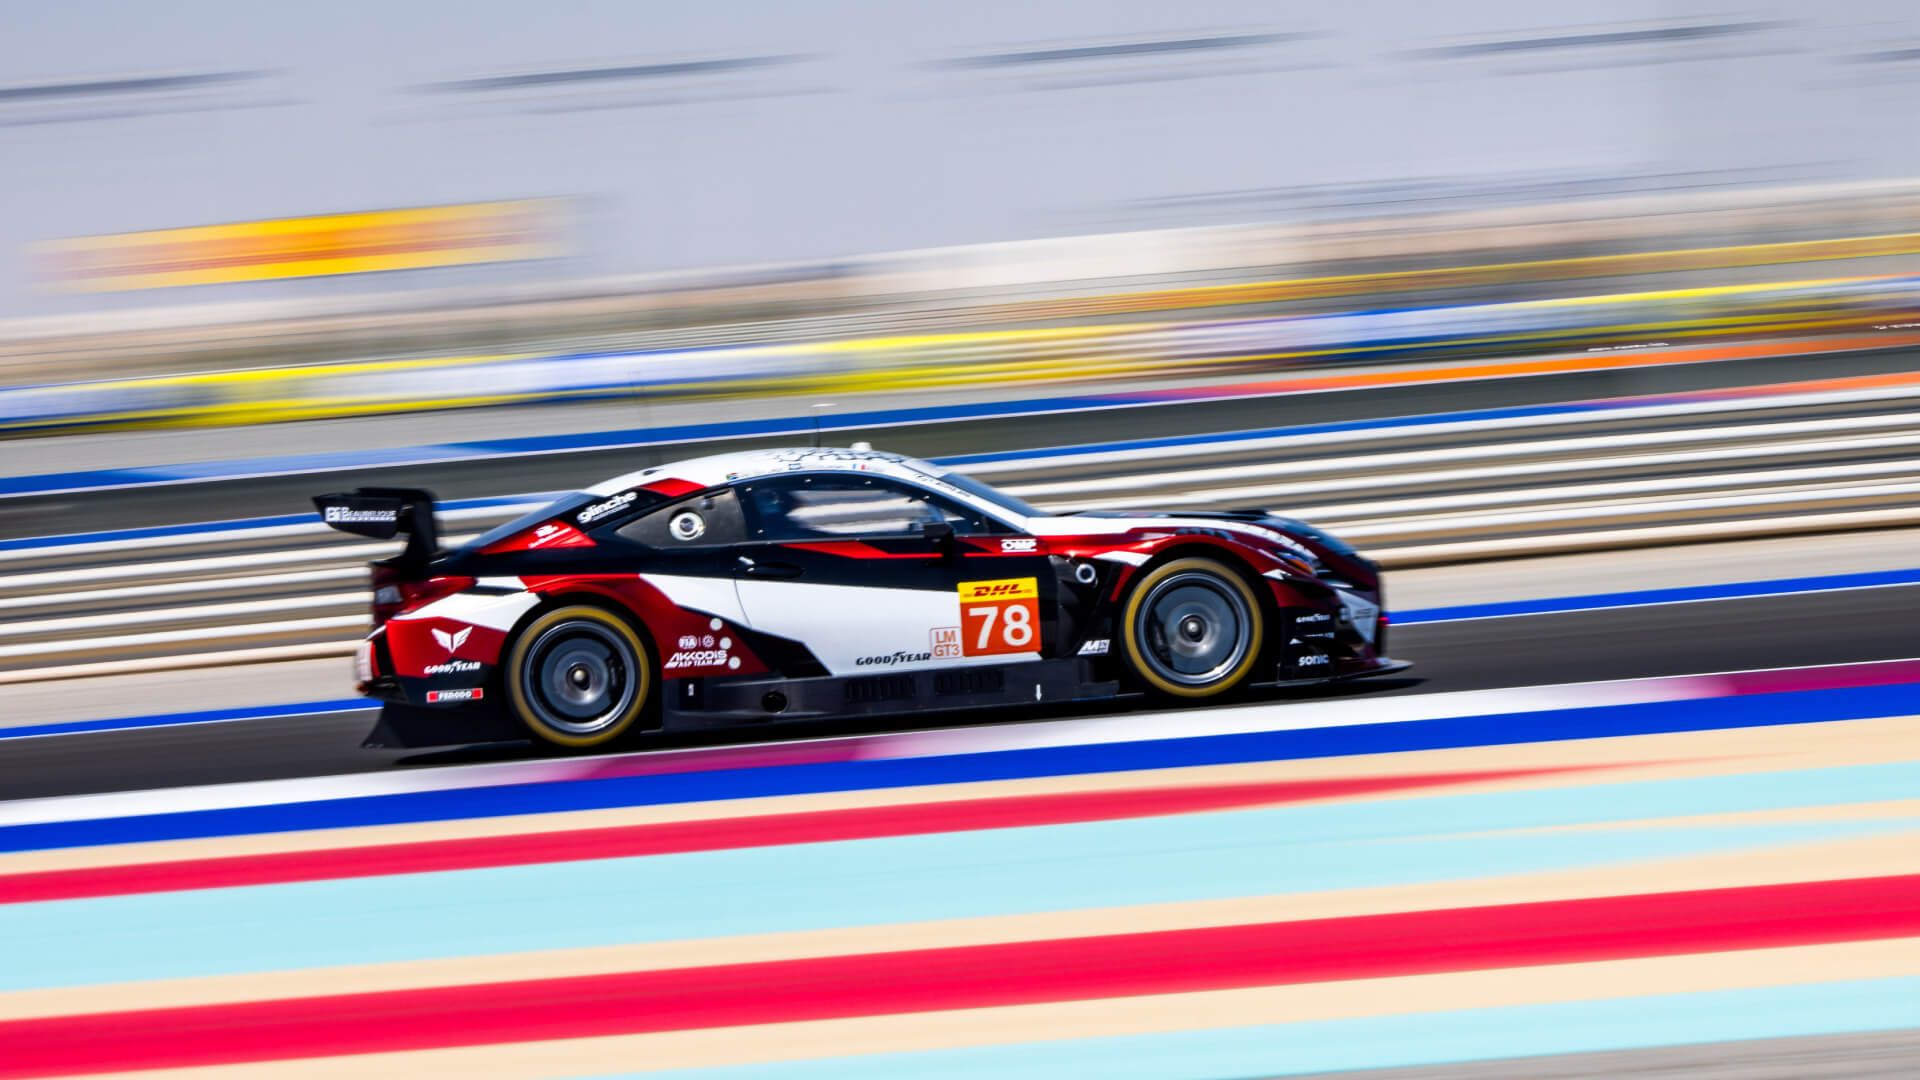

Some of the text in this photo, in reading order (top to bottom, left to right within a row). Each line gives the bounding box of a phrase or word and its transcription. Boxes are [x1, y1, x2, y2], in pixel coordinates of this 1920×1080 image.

[974, 584, 1022, 597] DHL
[968, 604, 1033, 649] 78
[679, 636, 697, 648] FIA
[936, 630, 956, 644] LM
[668, 650, 727, 662] AKKODIS
[933, 643, 960, 657] GT3
[856, 651, 931, 666] GOODYEAR
